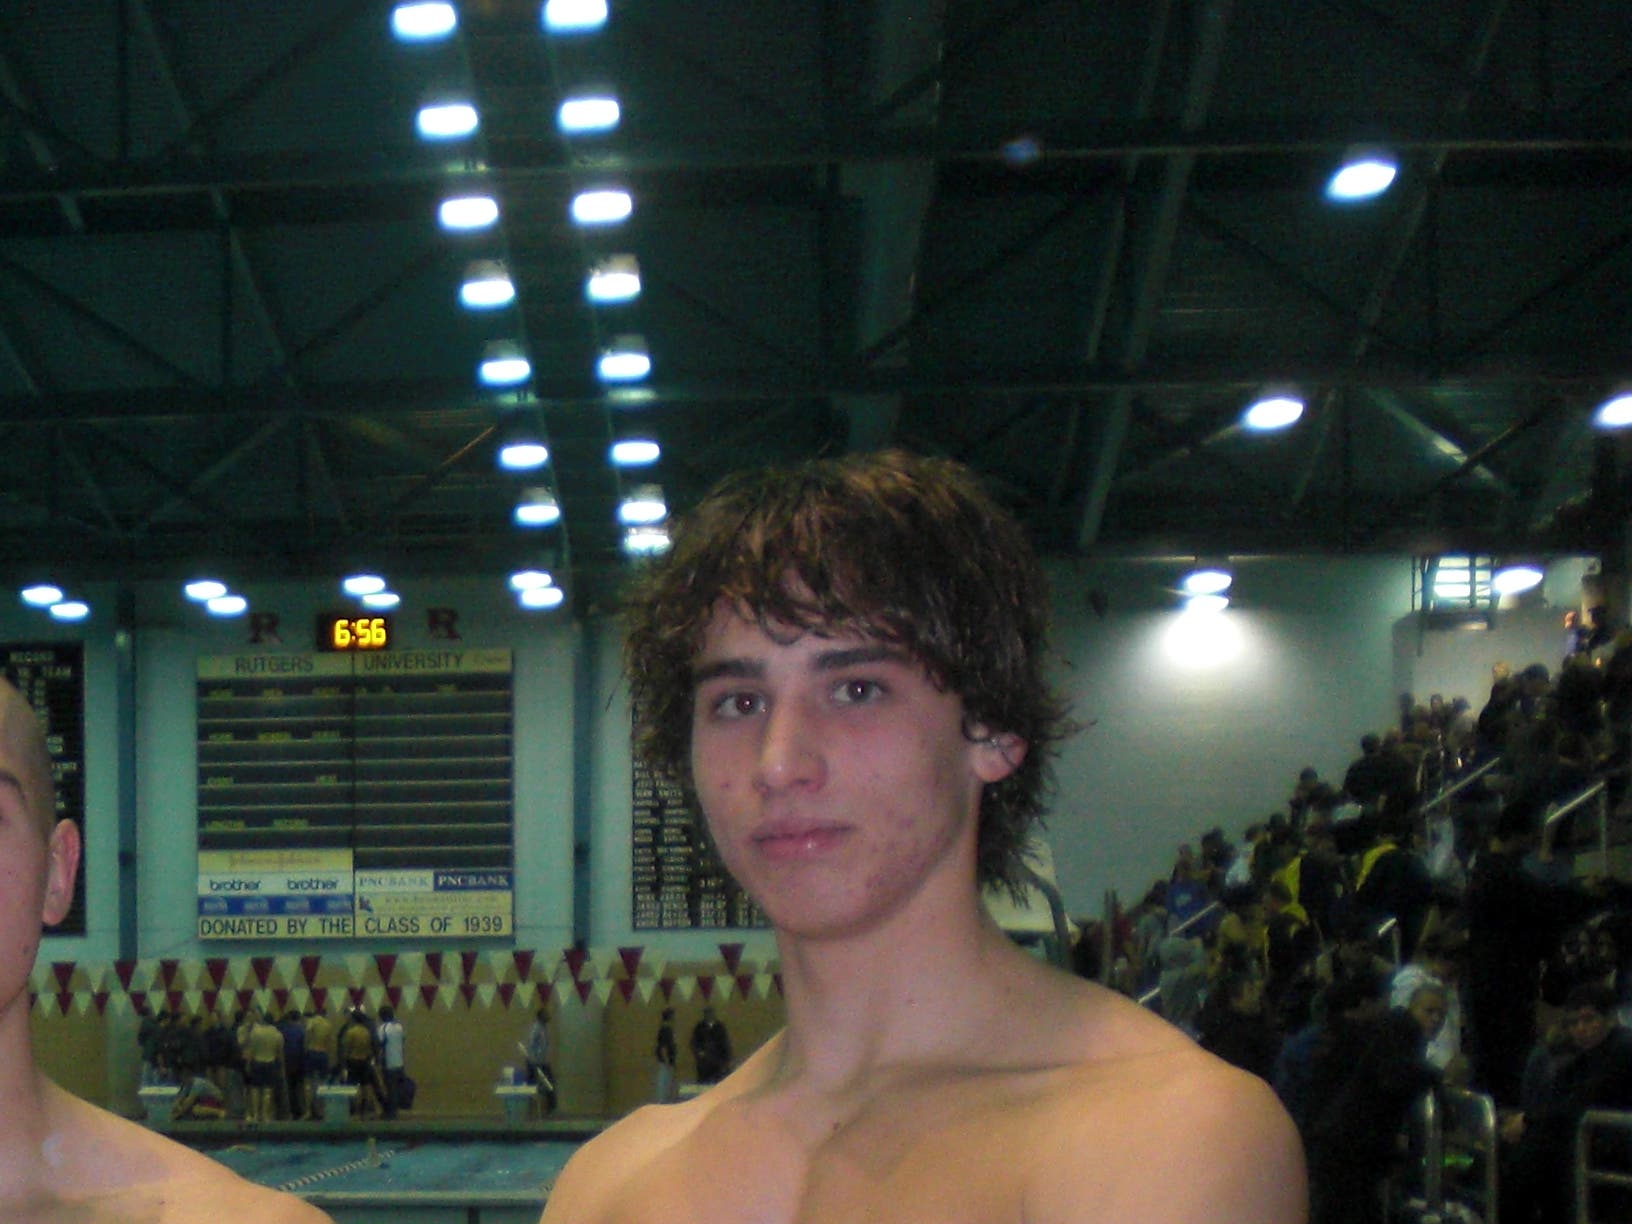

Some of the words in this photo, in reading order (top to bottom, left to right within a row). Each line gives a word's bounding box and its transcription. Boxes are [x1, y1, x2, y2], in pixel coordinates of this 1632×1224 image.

[249, 613, 282, 643] R
[334, 618, 386, 647] 6:56
[427, 608, 462, 640] R
[235, 656, 313, 673] RUTGERS
[364, 652, 462, 671] UNIVERSITY
[210, 879, 261, 891] brother
[287, 878, 339, 891] brother
[201, 918, 278, 936] DONATED
[288, 918, 308, 935] BY
[319, 917, 351, 934] THE
[365, 917, 420, 934] CLASS
[431, 917, 452, 933] OF
[464, 916, 502, 933] 1939
